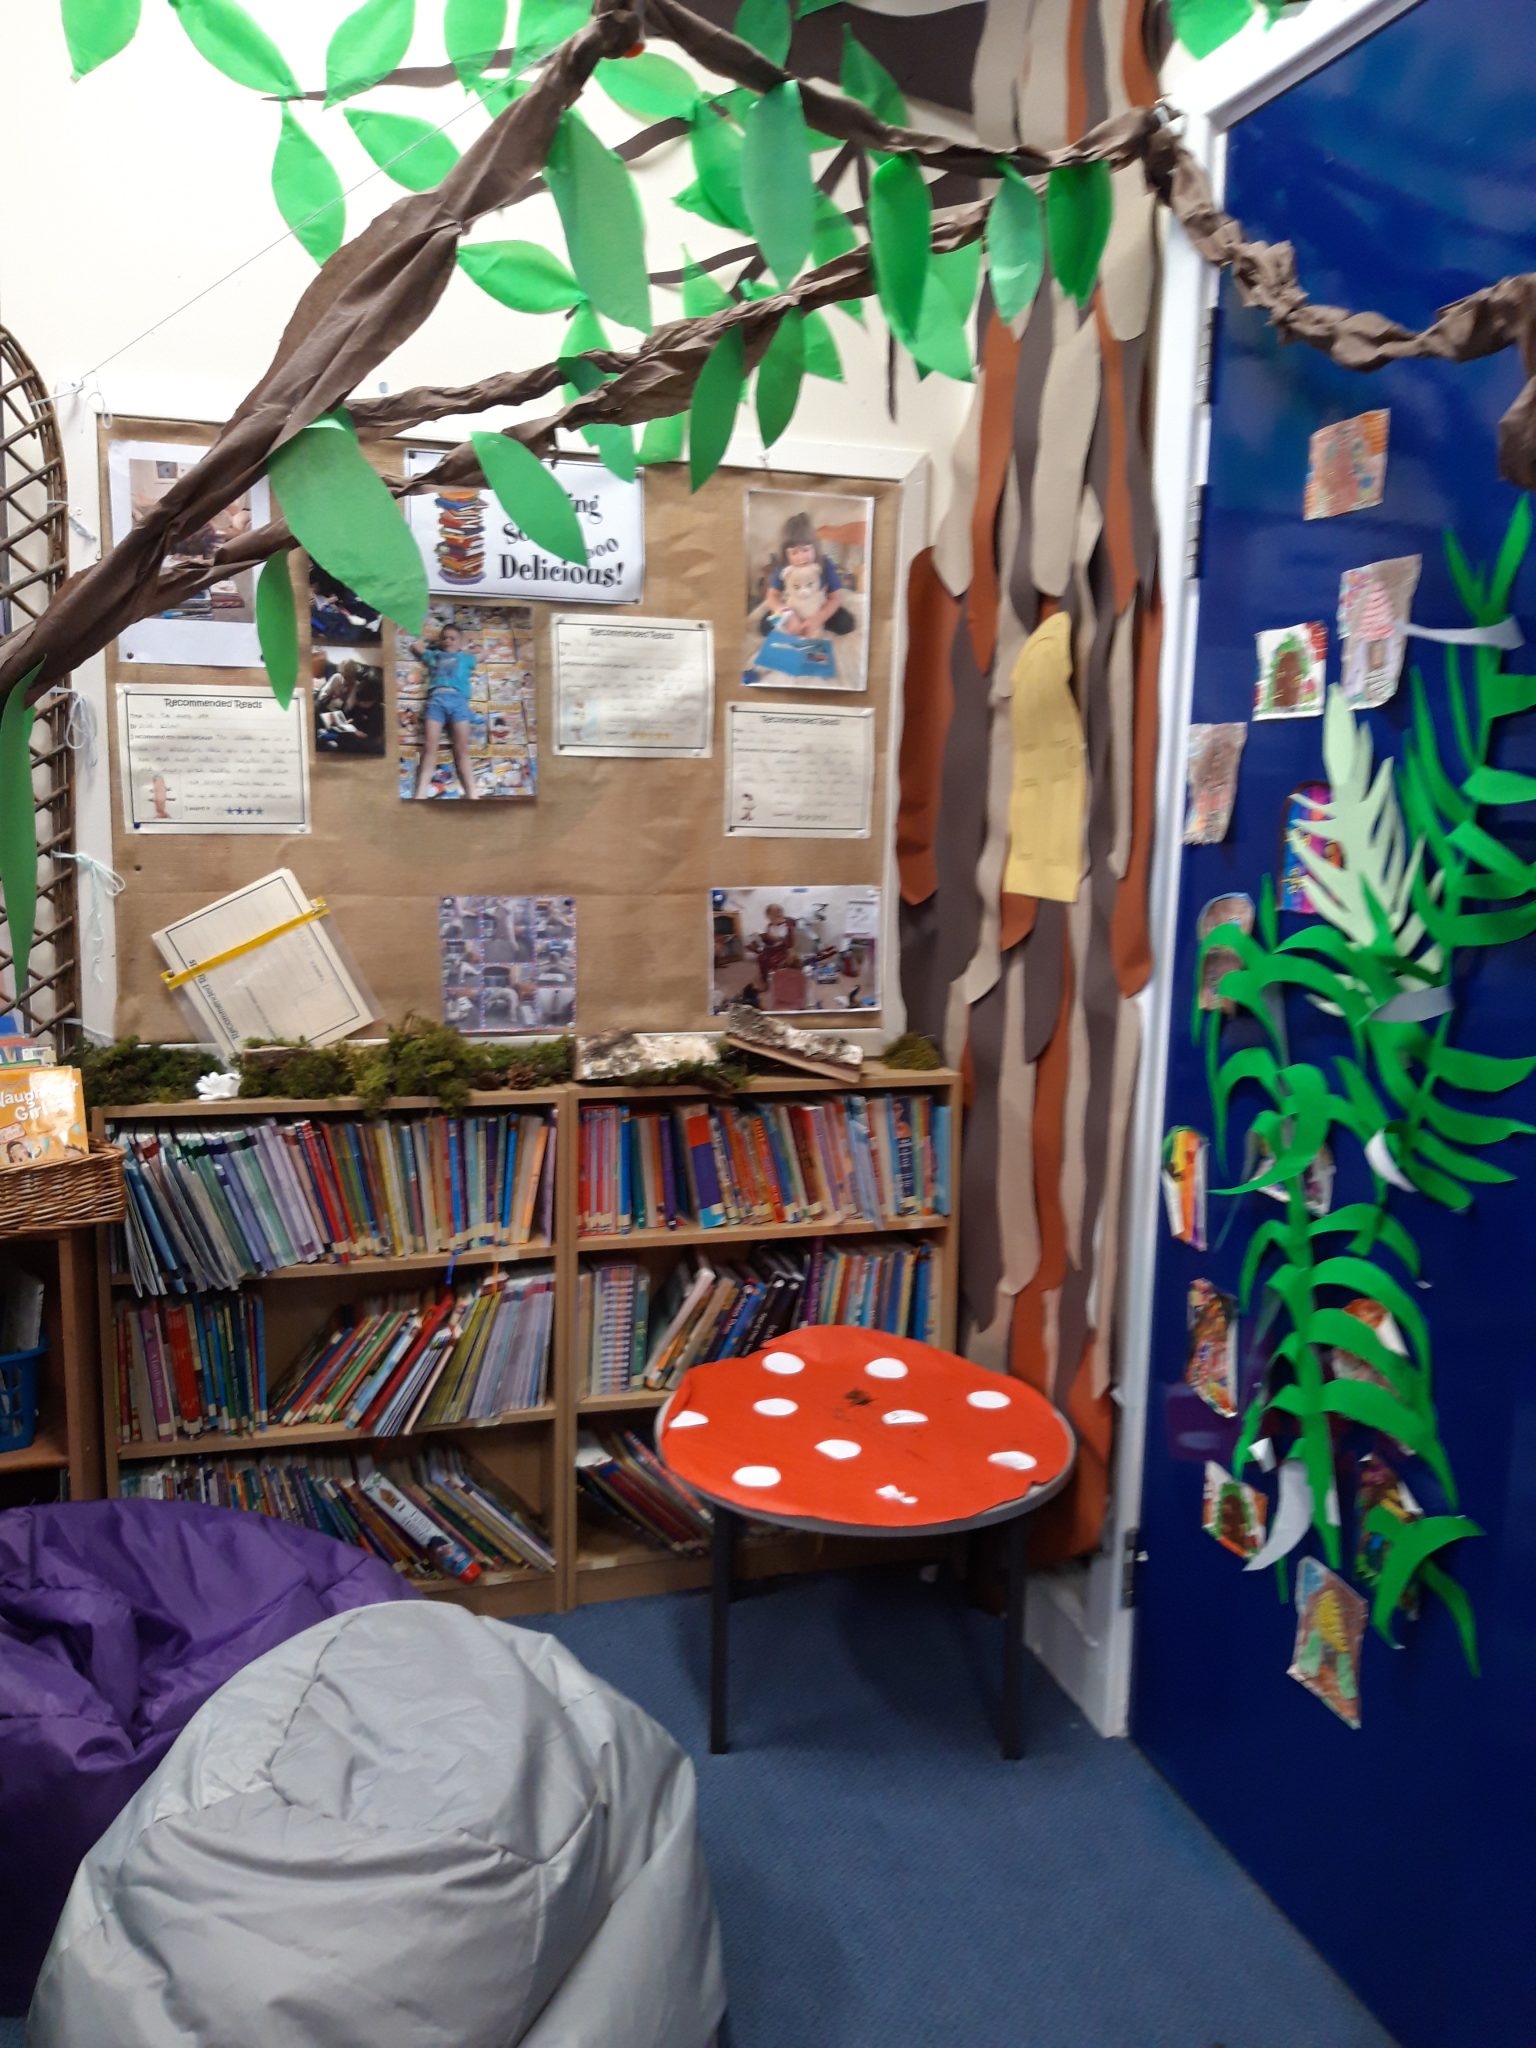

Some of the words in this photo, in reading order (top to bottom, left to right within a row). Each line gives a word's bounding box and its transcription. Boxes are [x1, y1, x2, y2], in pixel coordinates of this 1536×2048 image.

[498, 553, 624, 587] Delicious!
[164, 698, 232, 708] Recommended
[234, 699, 263, 709] Reads
[15, 1099, 49, 1121] Girl
